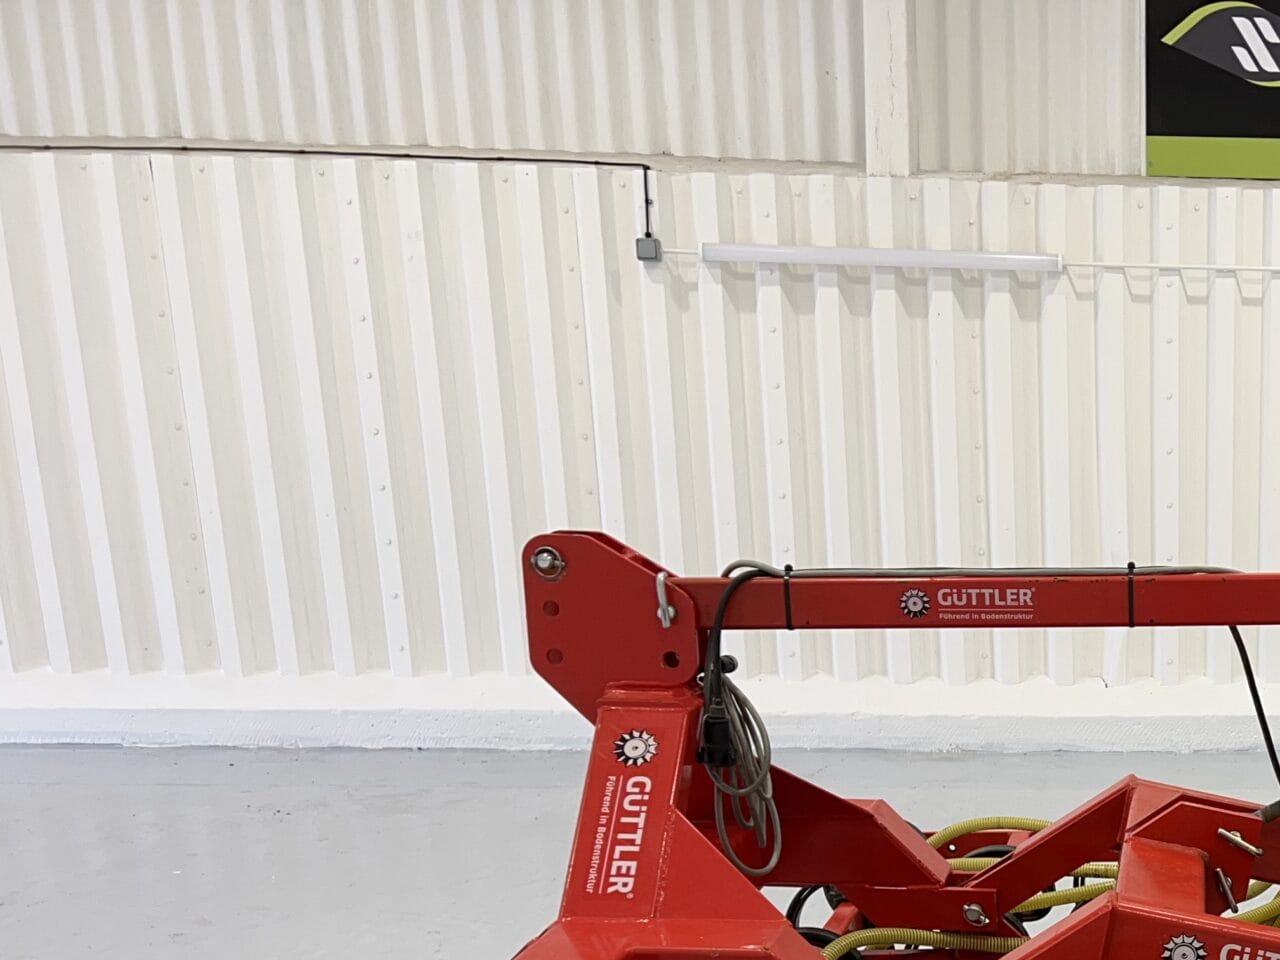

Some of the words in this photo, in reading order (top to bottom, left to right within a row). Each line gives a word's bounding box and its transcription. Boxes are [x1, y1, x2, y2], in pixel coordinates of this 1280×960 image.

[602, 775, 616, 813] Führend
[599, 815, 609, 824] in
[586, 826, 607, 894] Bodenstruktur
